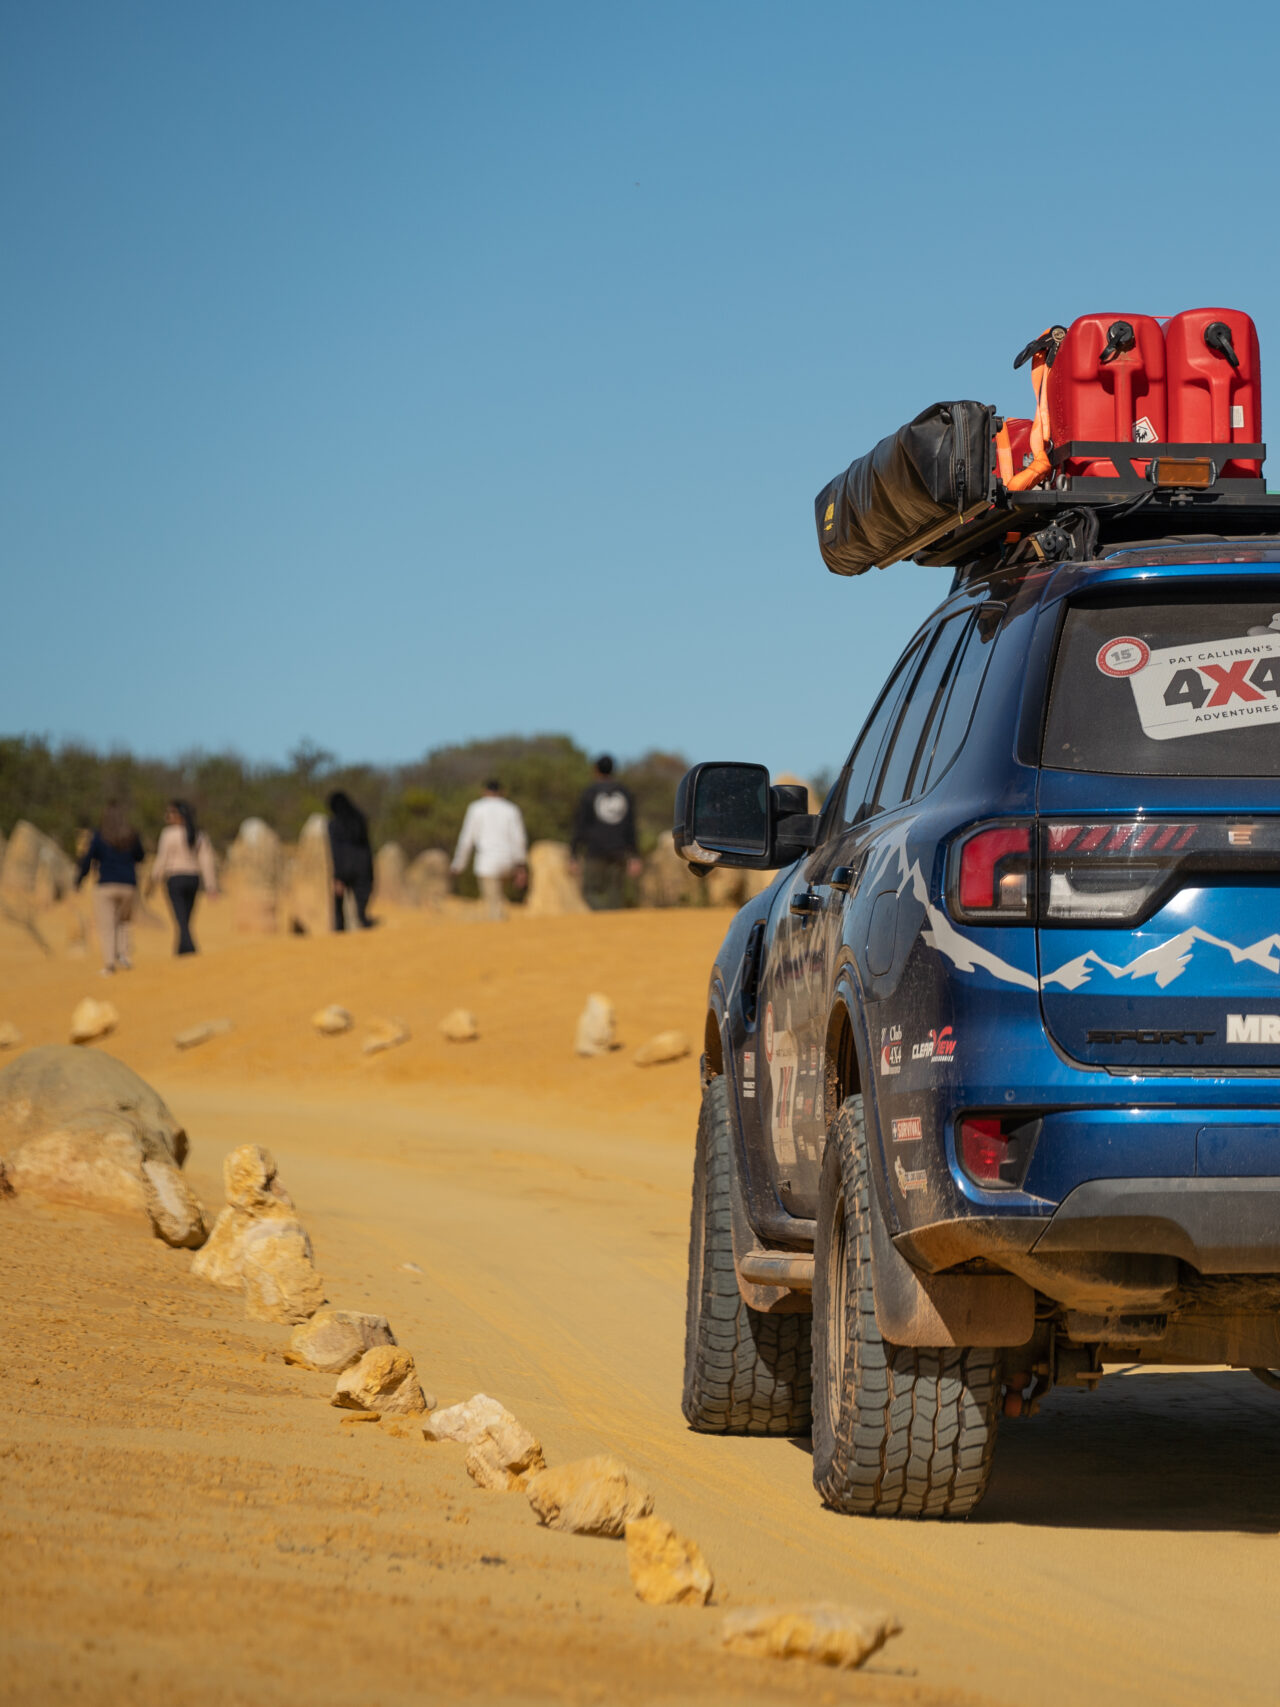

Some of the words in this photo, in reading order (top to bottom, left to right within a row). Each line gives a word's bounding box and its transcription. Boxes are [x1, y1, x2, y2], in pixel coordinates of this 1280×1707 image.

[1110, 649, 1132, 661] 15
[1168, 654, 1193, 665] PAT
[1198, 644, 1273, 662] CALLINAN'S
[1194, 704, 1280, 723] ADVENTURES
[1086, 1029, 1217, 1045] SPORT
